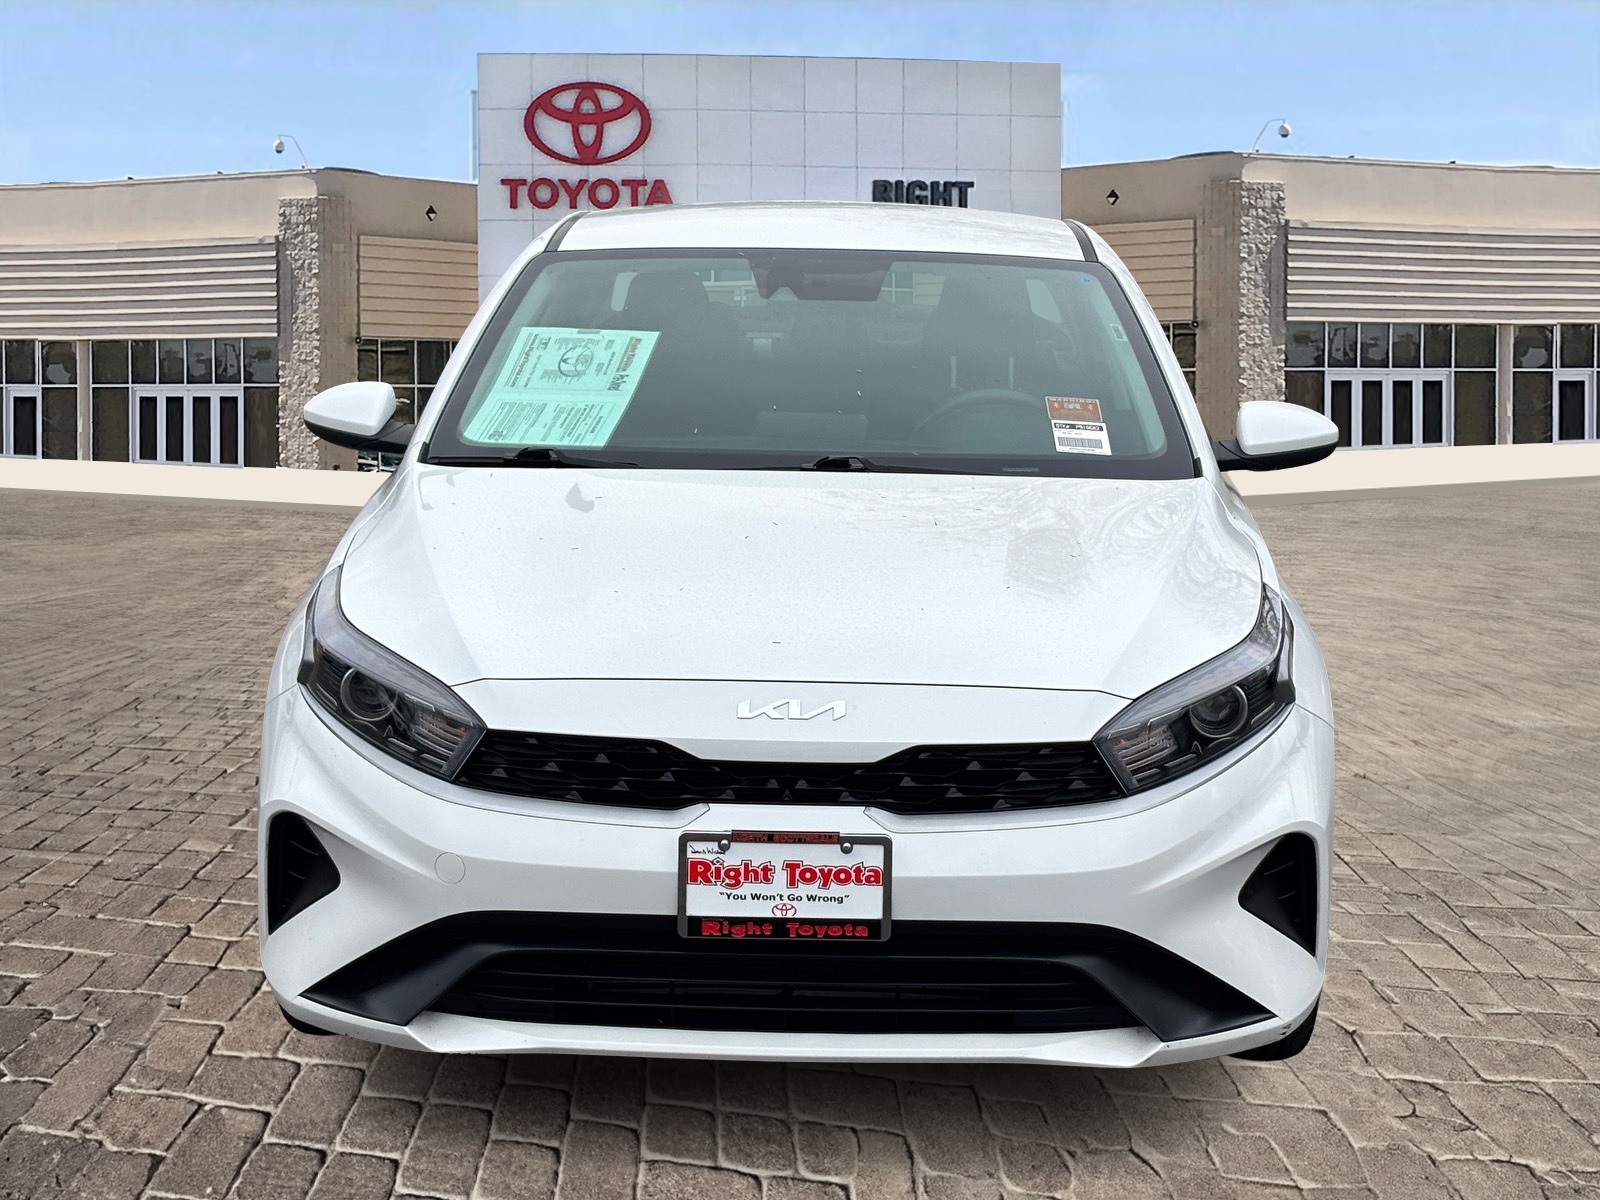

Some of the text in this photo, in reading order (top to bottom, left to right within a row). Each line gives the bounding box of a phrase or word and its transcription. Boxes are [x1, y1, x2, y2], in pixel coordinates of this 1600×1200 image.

[500, 177, 673, 209] TOYOTA
[872, 179, 975, 208] RIGHT
[737, 698, 847, 721] KIA
[687, 857, 884, 890] Right Toyota
[787, 894, 803, 902] Go
[702, 921, 869, 938] Right Toyota
